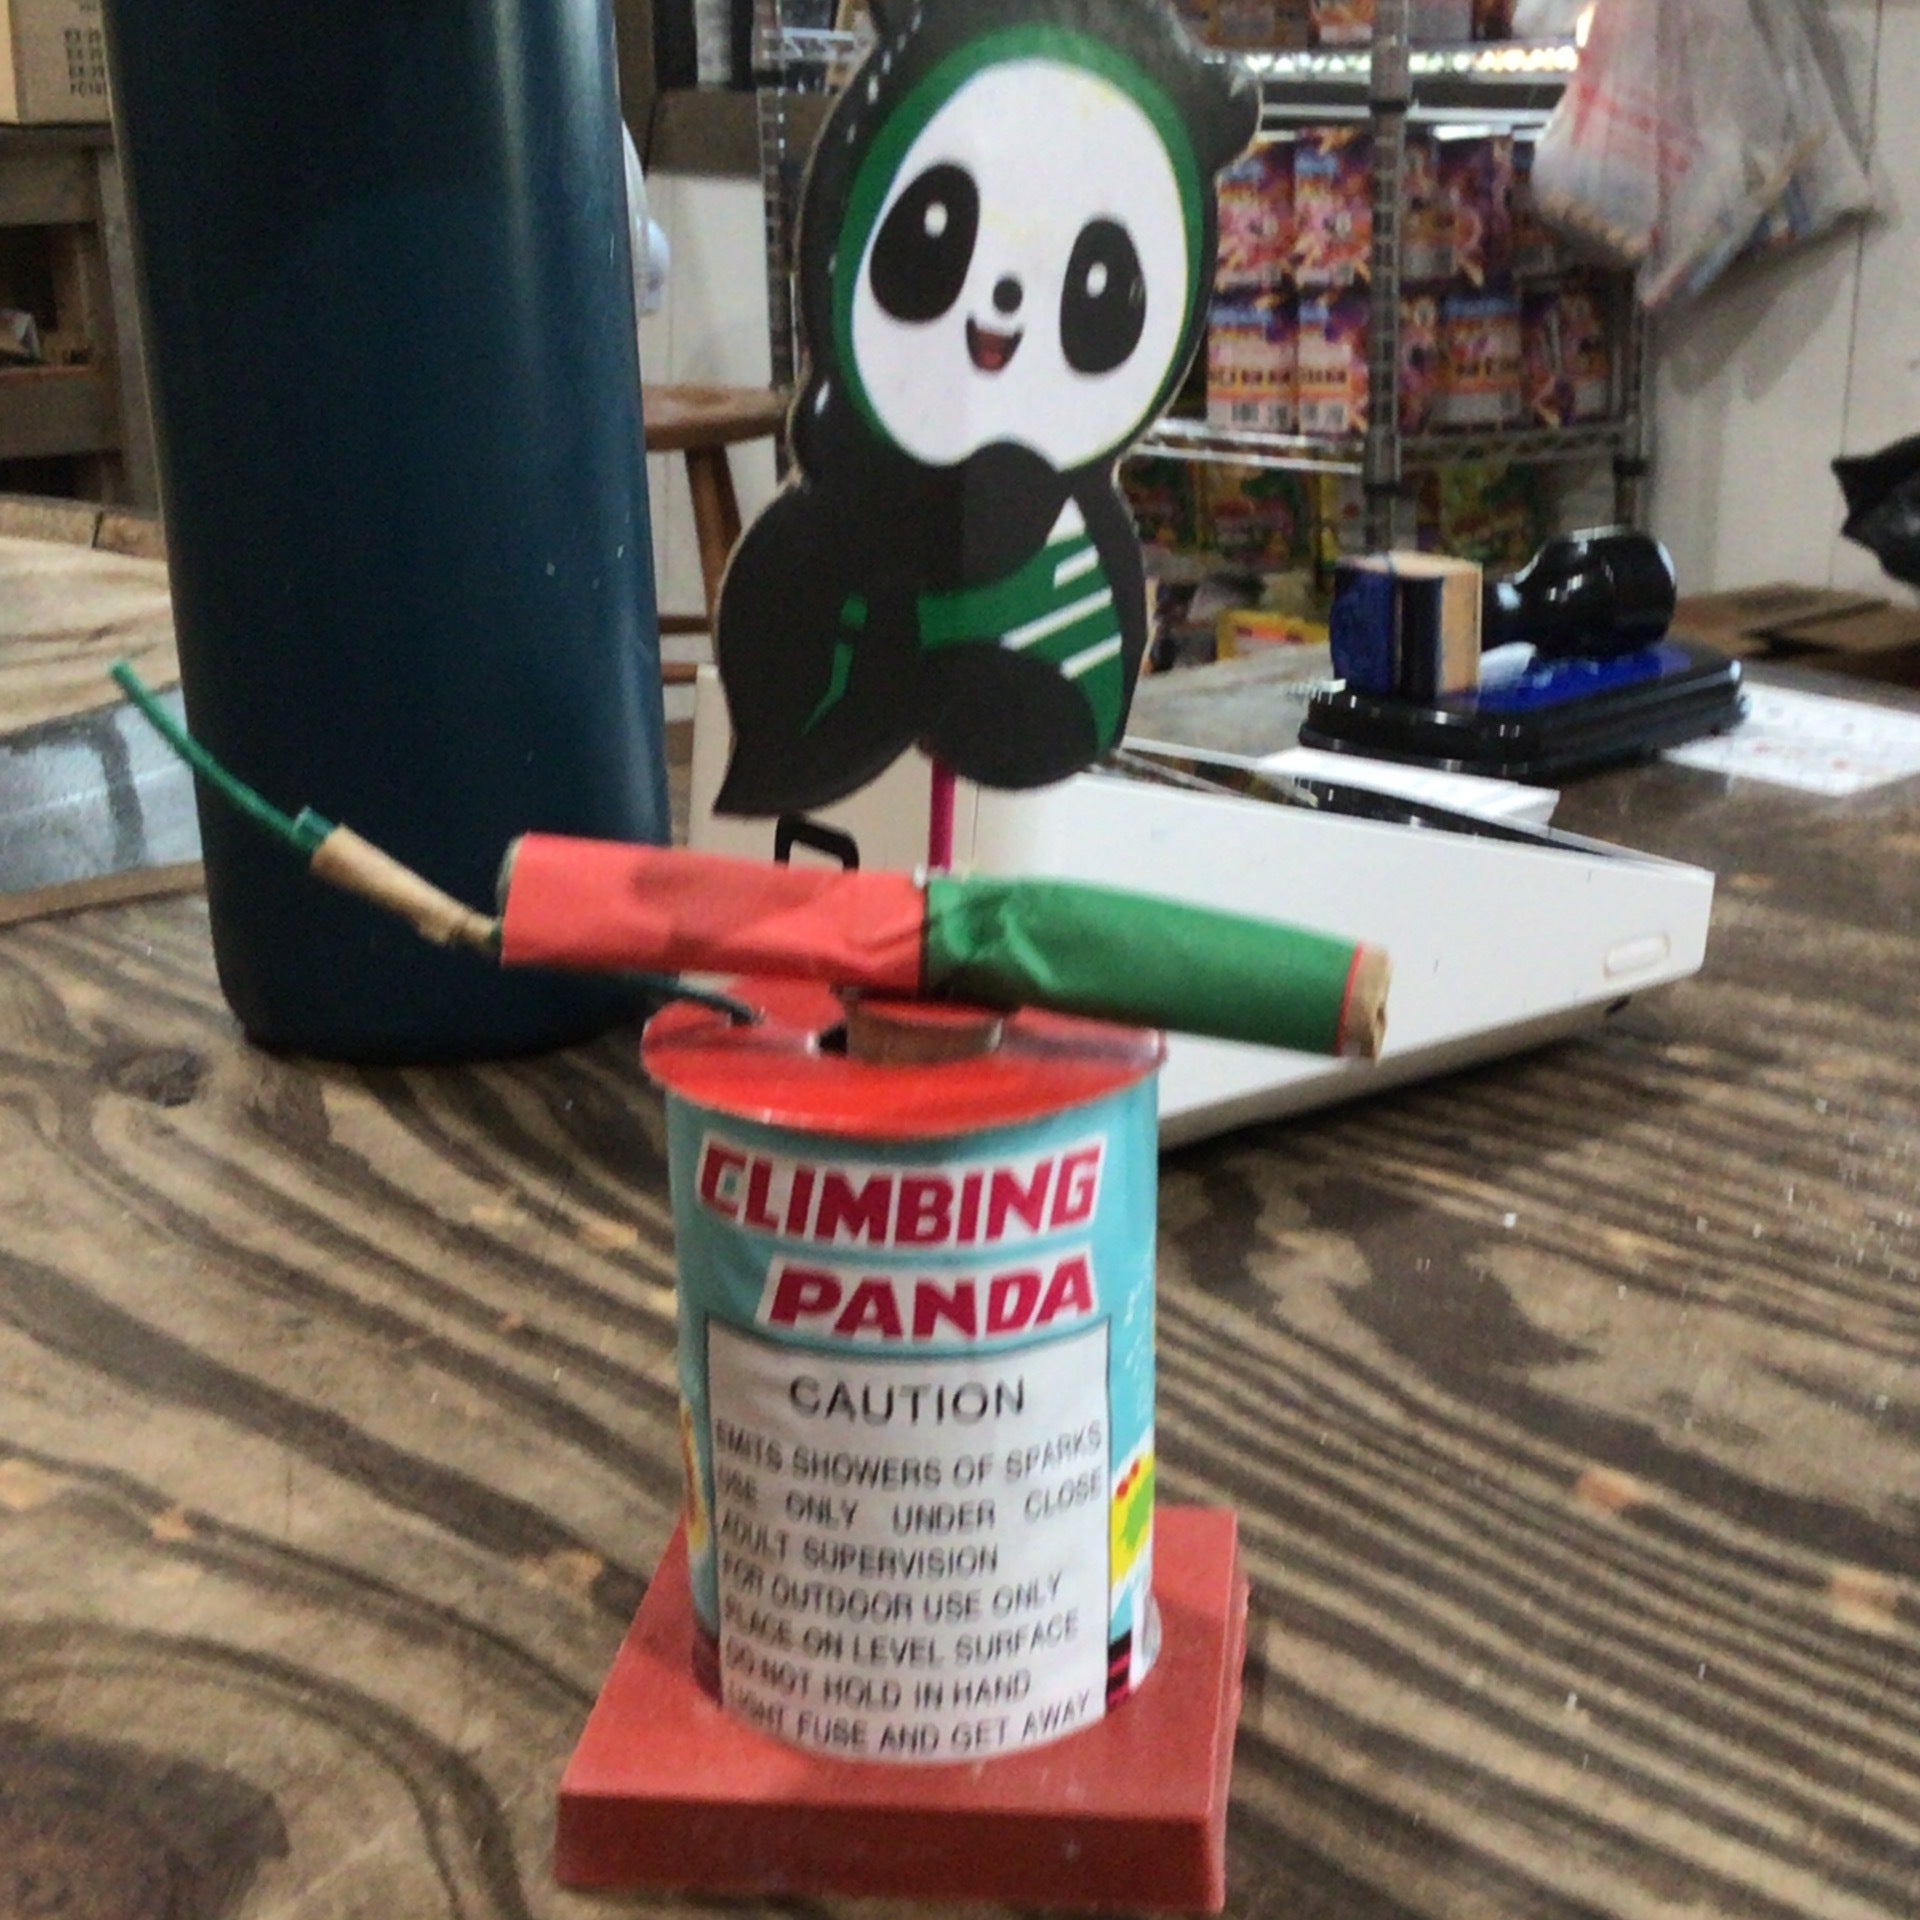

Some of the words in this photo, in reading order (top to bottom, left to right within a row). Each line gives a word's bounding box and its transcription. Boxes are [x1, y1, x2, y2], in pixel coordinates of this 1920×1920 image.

[700, 1141, 1102, 1247] CLIMBING
[768, 1252, 1093, 1342] PANDA
[788, 1375, 1025, 1425] CAUTION
[792, 1443, 942, 1490] SHOWERS
[952, 1453, 994, 1489] OF
[1005, 1418, 1102, 1484] SPARKS
[785, 1488, 858, 1531] ONLY
[892, 1498, 996, 1536] UNDER
[1024, 1466, 1102, 1524] CLOSE
[721, 1507, 790, 1561] ADULT
[803, 1533, 998, 1579] SUPERVISION
[723, 1551, 765, 1597] FOR
[771, 1572, 913, 1625] OUTDOOR
[923, 1589, 983, 1624] USE
[992, 1569, 1063, 1619] ONLY
[802, 1626, 844, 1662] ON
[852, 1632, 944, 1669] LEVEL
[955, 1607, 1078, 1665] SURFACE
[761, 1658, 810, 1699] NOT
[824, 1672, 901, 1712] HOLD
[915, 1678, 943, 1711] IN
[953, 1668, 1032, 1708] HAND
[797, 1708, 868, 1750] FUSE
[879, 1721, 940, 1755] AND
[951, 1714, 1010, 1752] GET
[1021, 1688, 1091, 1742] AWAY
